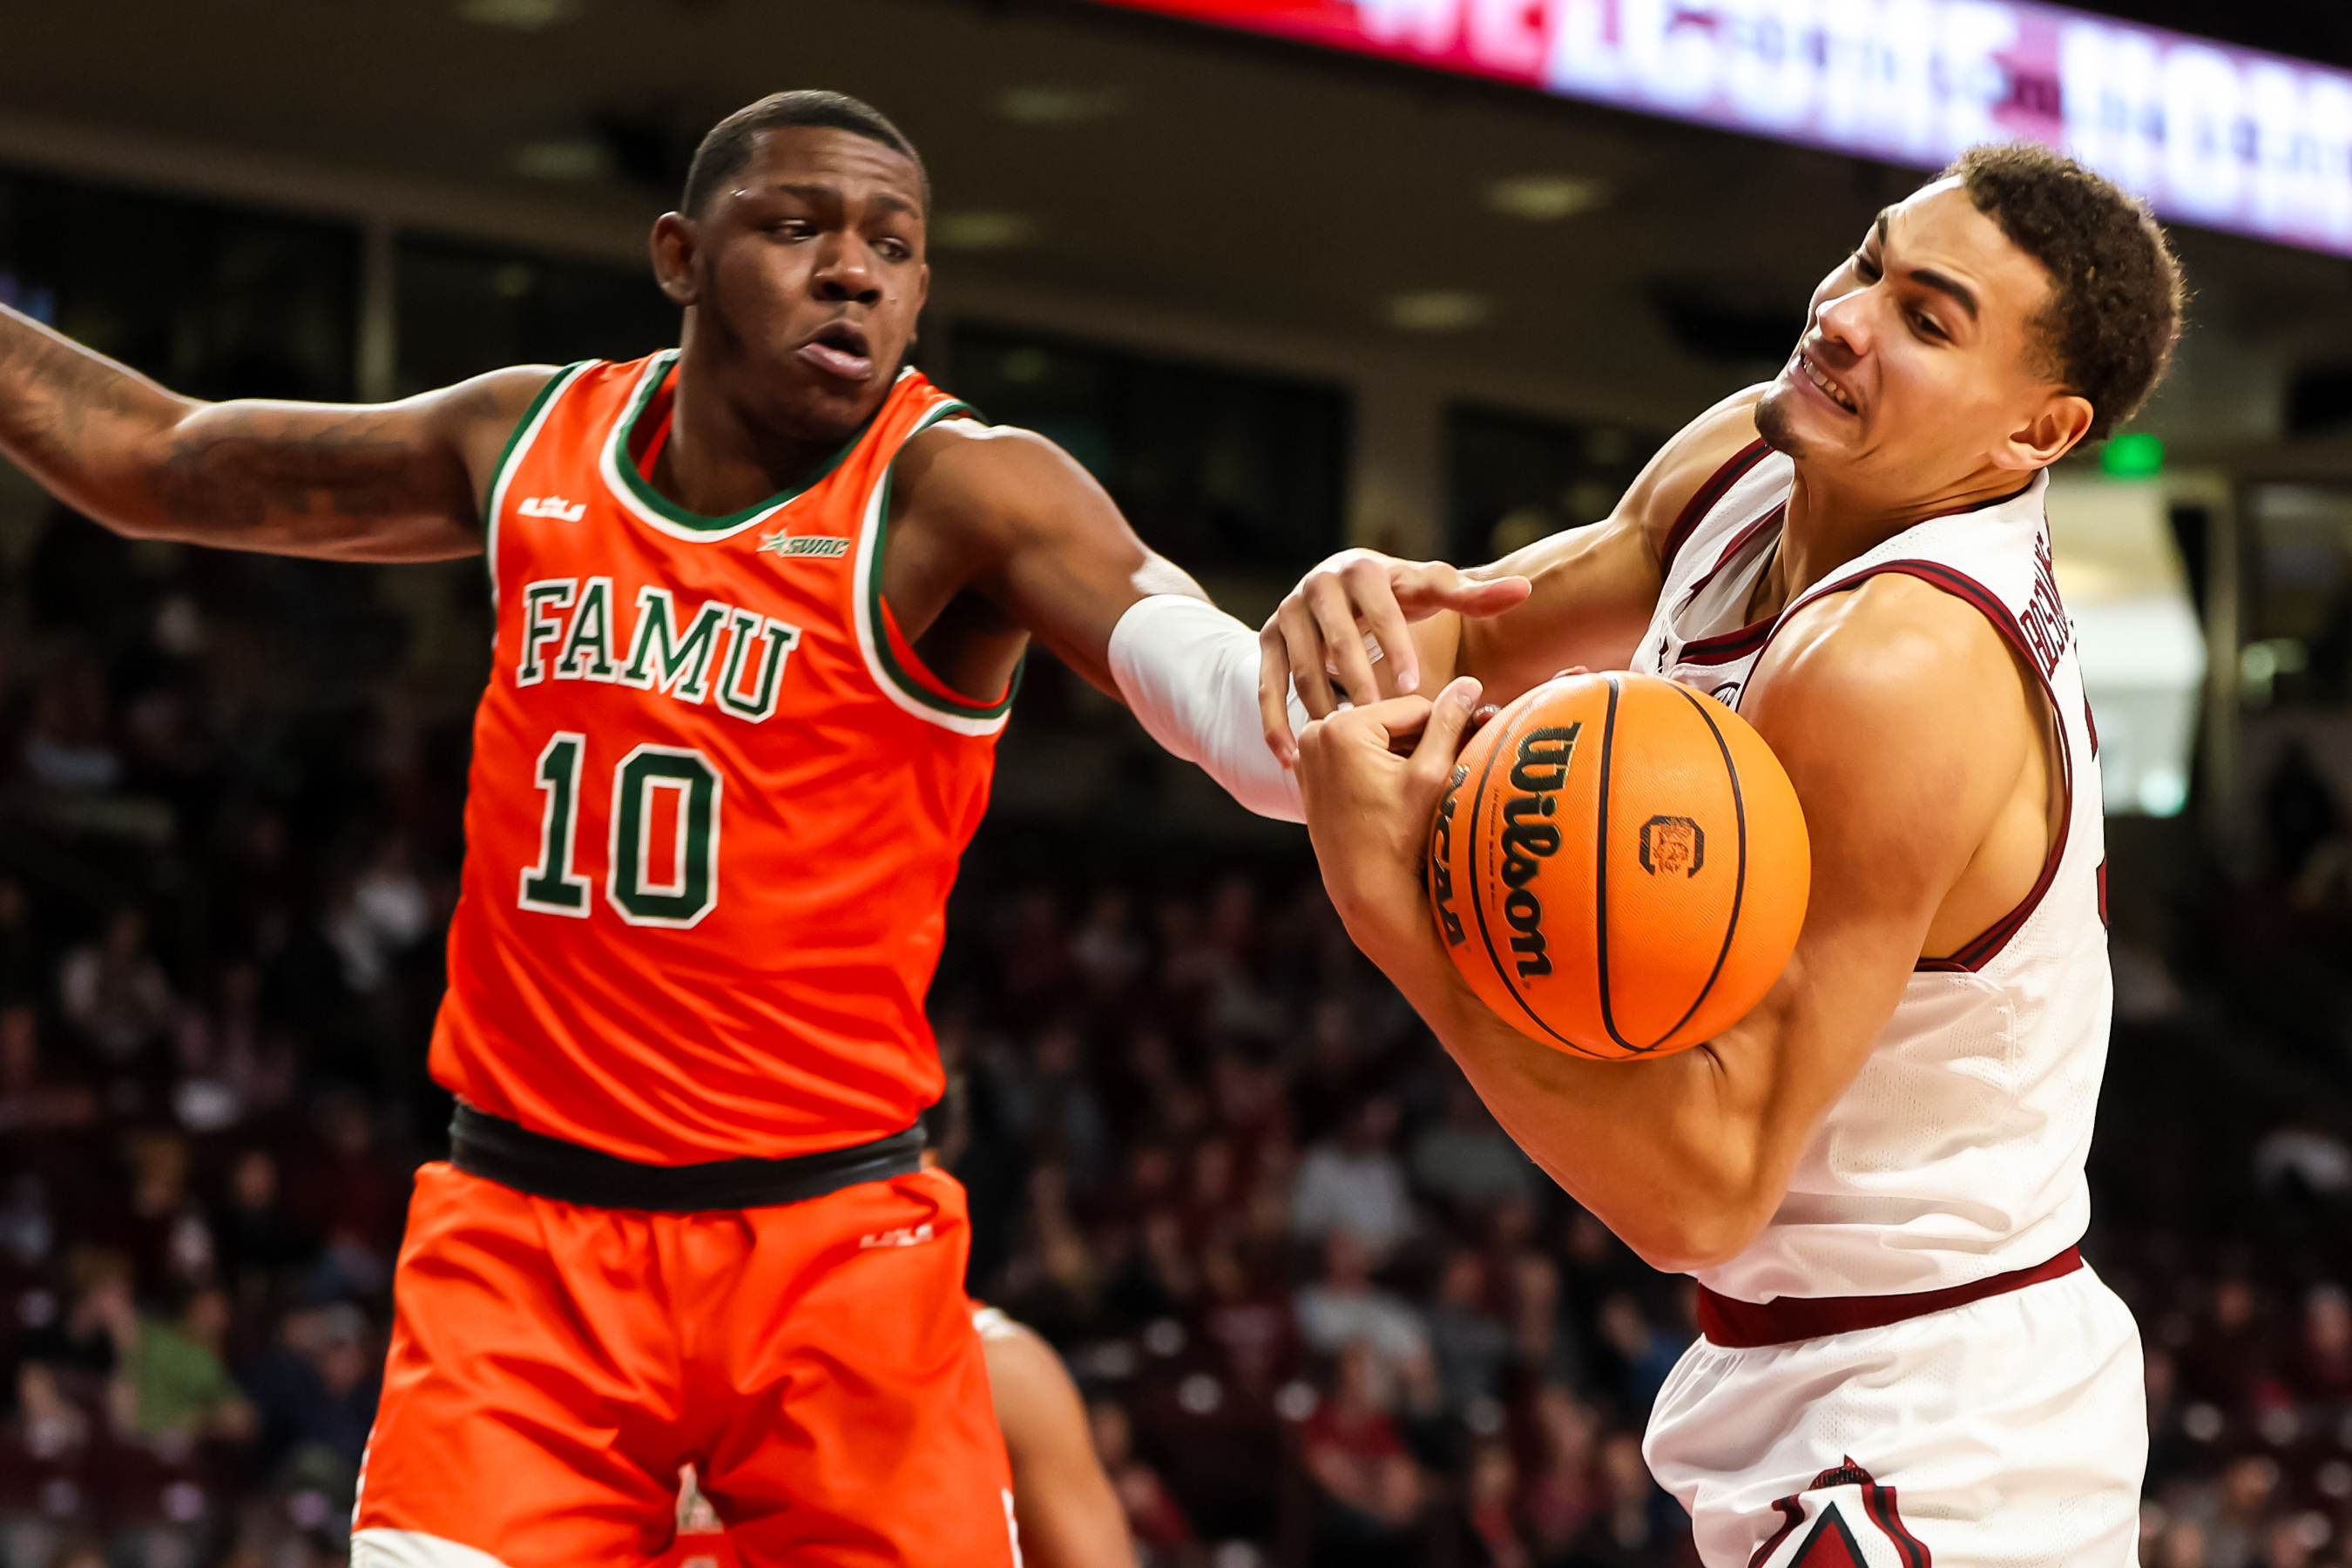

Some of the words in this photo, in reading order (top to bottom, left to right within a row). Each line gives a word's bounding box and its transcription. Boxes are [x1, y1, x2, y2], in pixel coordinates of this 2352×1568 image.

[783, 538, 850, 555] SWAC
[516, 576, 802, 724] FAMU
[517, 730, 724, 929] 10
[1500, 721, 1584, 979] Wilson
